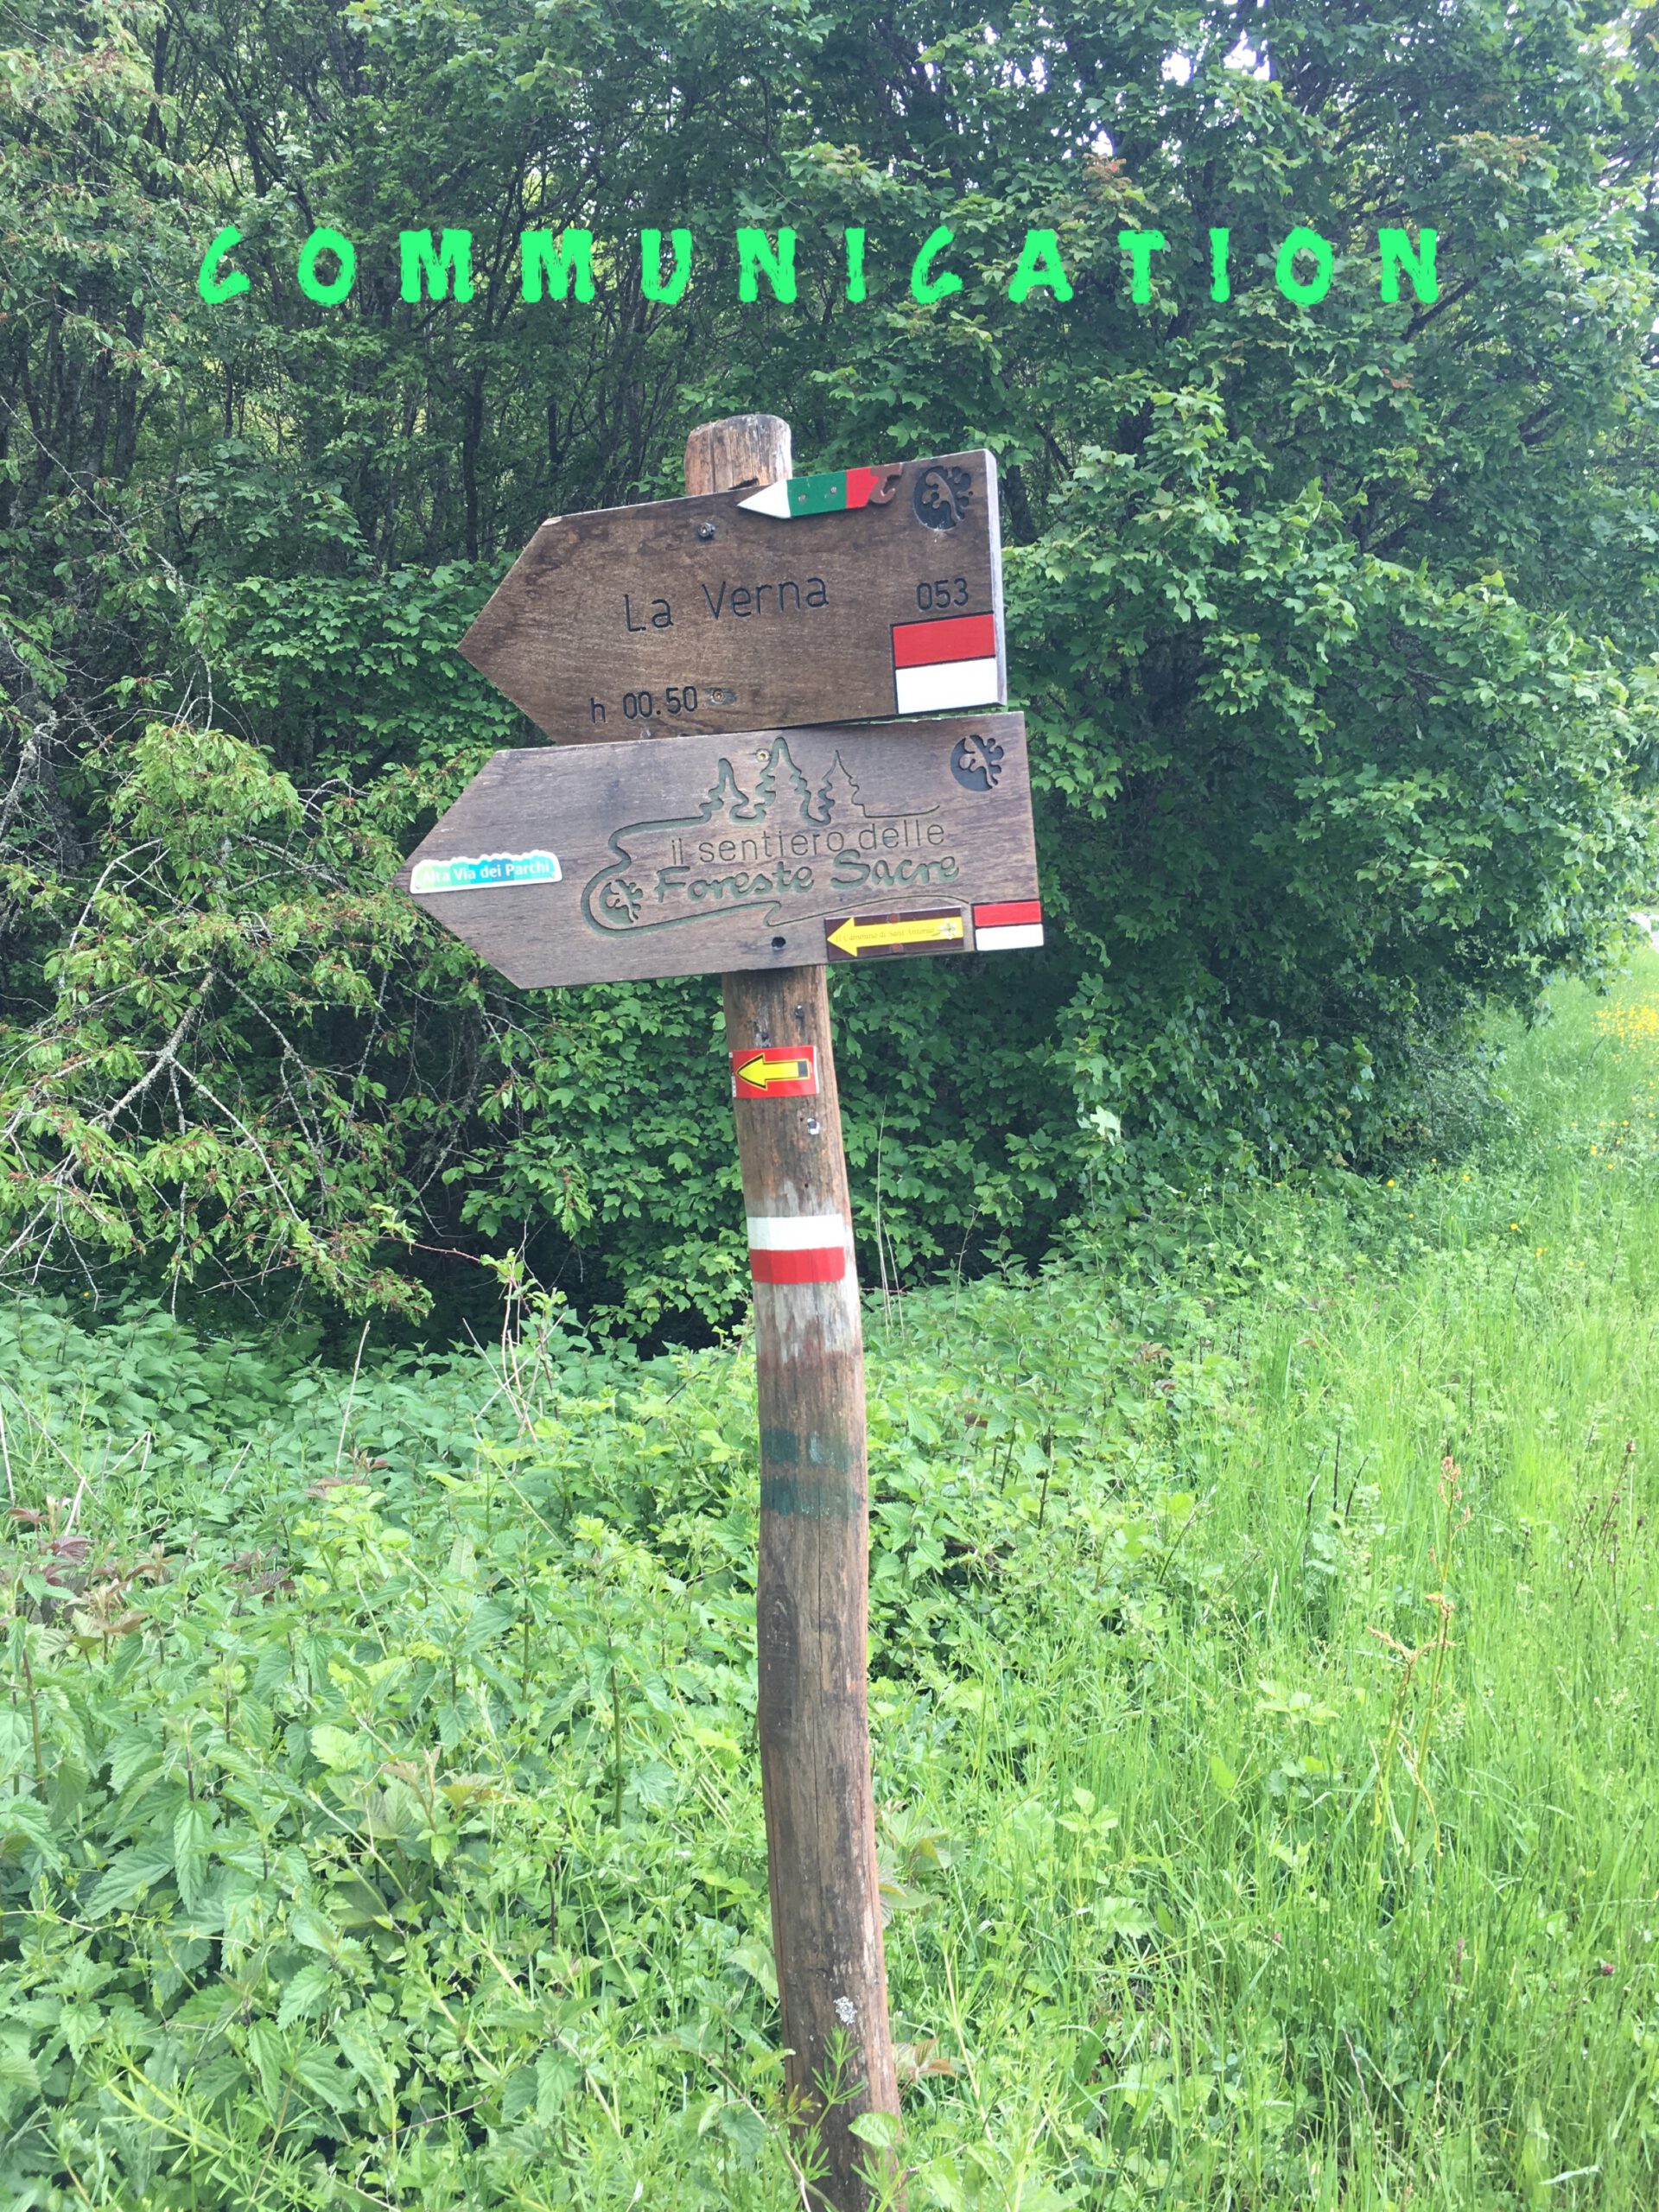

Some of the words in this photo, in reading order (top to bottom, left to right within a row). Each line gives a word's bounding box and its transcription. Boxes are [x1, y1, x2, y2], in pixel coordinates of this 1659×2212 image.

[624, 594, 673, 632] La
[702, 576, 829, 620] Verna
[916, 578, 969, 611] 053
[590, 697, 606, 723] h
[622, 686, 698, 720] 00.50
[671, 838, 683, 865] il
[698, 830, 844, 862] sentiero
[858, 820, 944, 851] delle
[423, 870, 450, 883] Alta
[454, 868, 475, 880] Via
[480, 865, 501, 878] dei
[505, 860, 550, 876] Parchi
[654, 861, 815, 903] Foreste
[830, 849, 960, 889] Sacre
